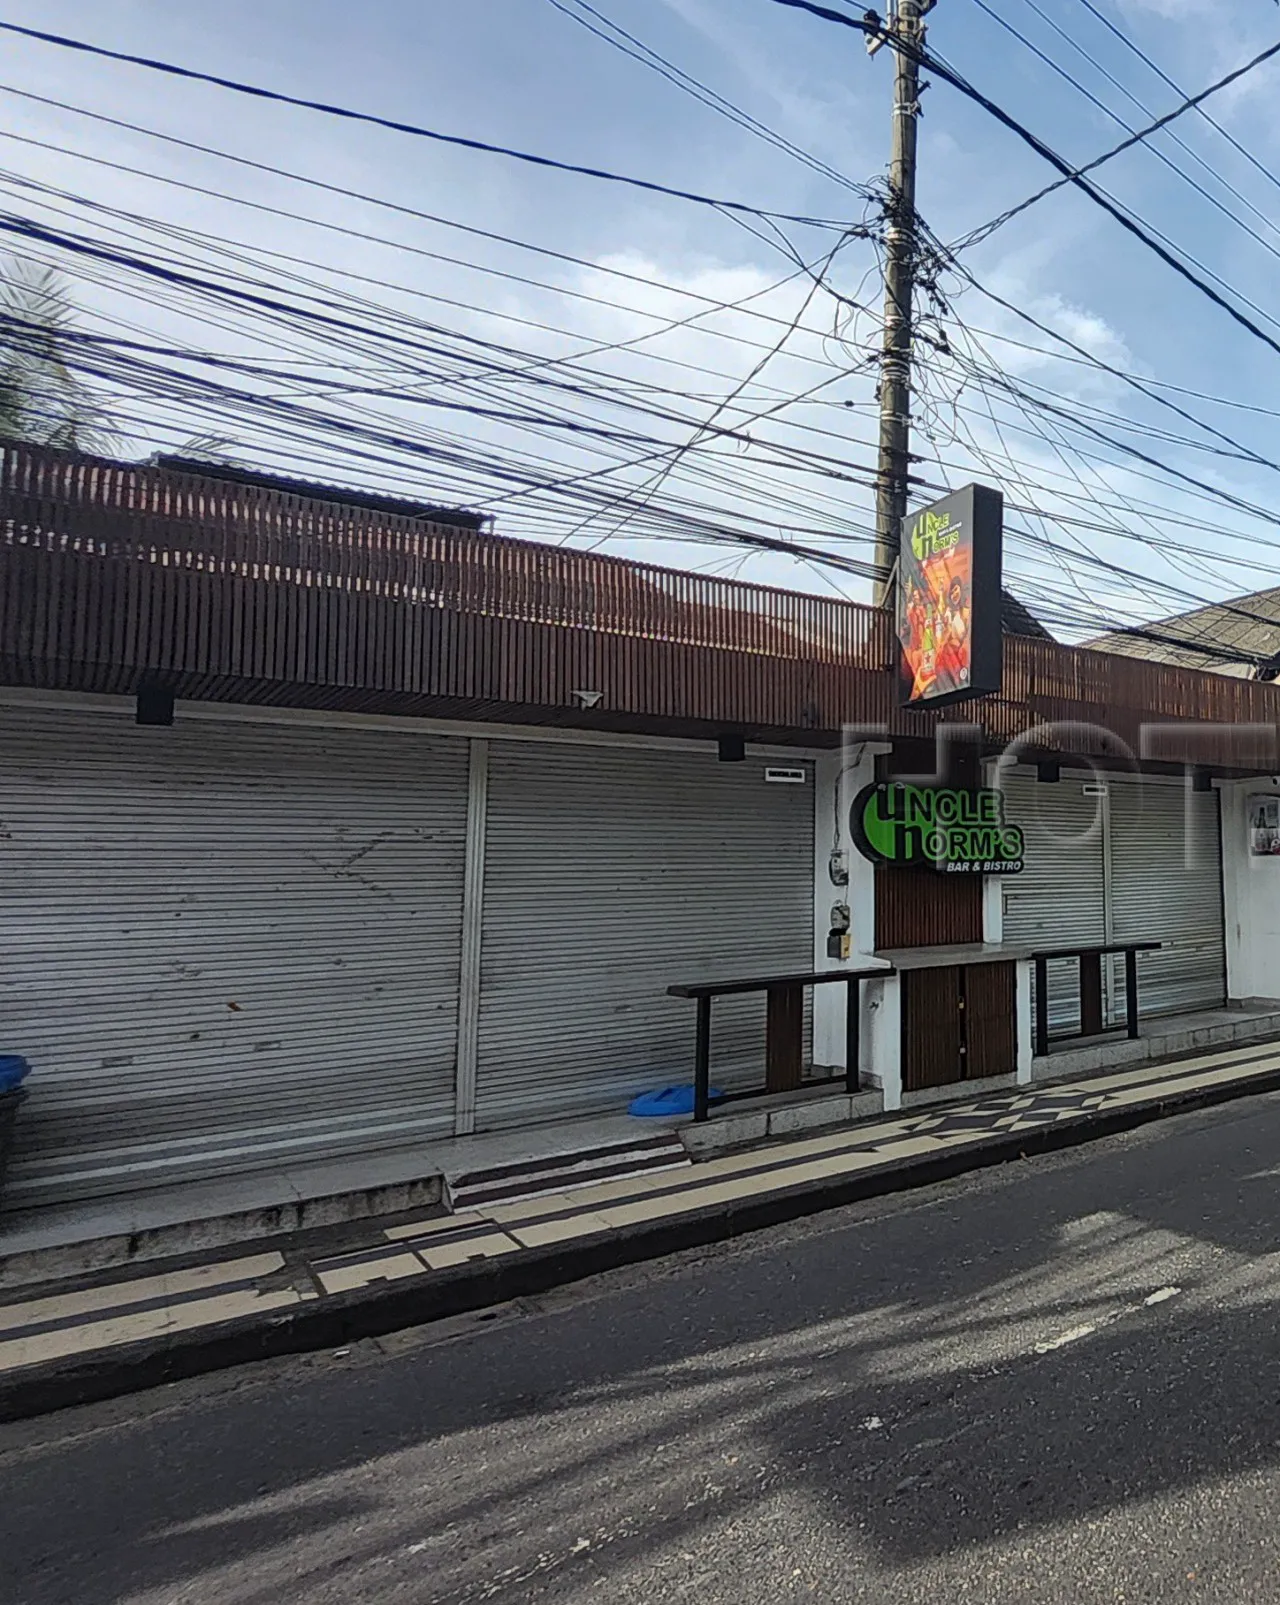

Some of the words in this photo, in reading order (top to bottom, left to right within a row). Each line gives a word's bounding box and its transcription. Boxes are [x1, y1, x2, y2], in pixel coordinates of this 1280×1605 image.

[876, 782, 1000, 824] UNCLE
[947, 861, 971, 872] BAR
[972, 862, 981, 872] &
[983, 860, 1022, 872] BISTRO
